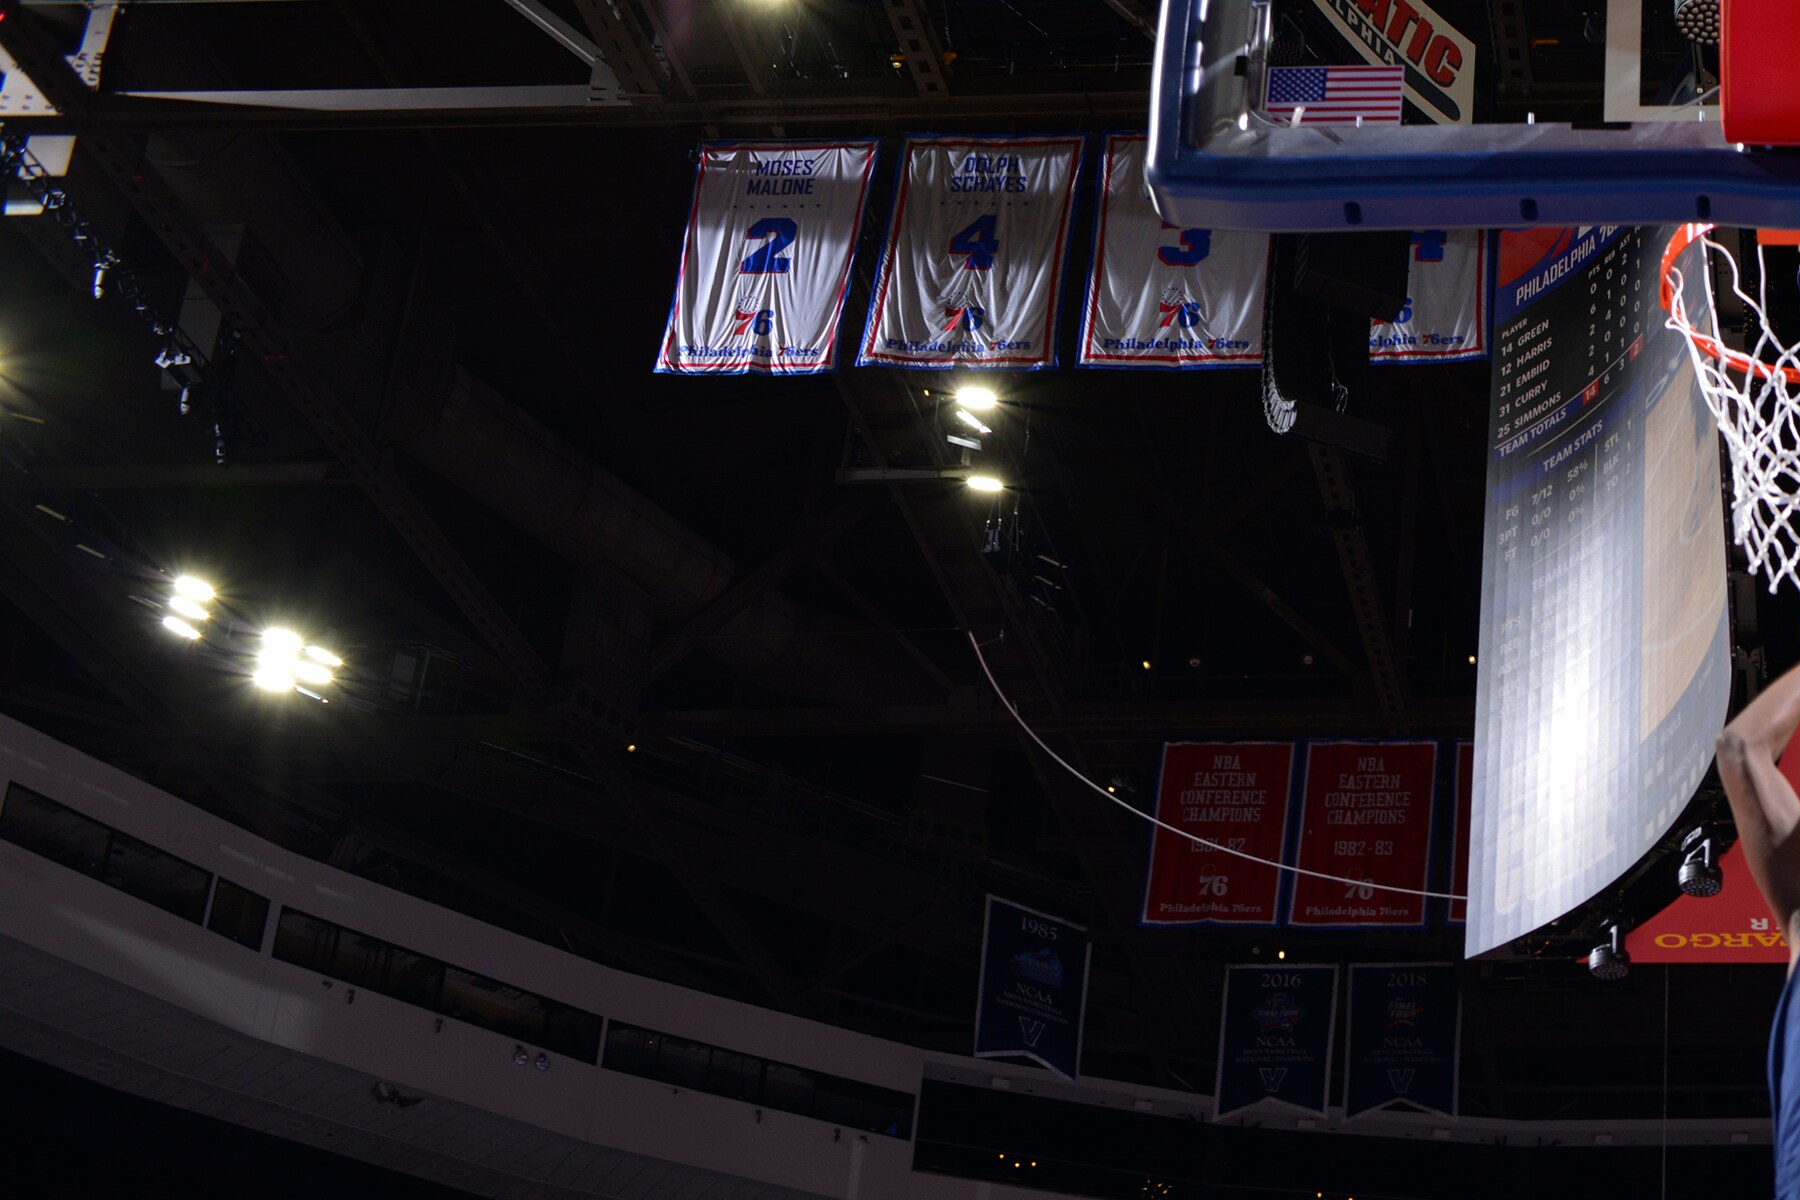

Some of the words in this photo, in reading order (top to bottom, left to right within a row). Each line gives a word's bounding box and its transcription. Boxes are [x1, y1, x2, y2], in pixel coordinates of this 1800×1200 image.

[756, 160, 814, 176] MOSES
[965, 156, 1020, 173] DOLPH
[747, 179, 815, 196] MALONE
[951, 176, 1026, 193] SCHAYES
[739, 218, 798, 274] 2
[948, 214, 1000, 270] 4
[1515, 237, 1596, 306] PHILADELPHIA
[1502, 318, 1528, 340] PLAYER
[1517, 319, 1549, 346] GREEN
[1104, 338, 1203, 351] Philadelphia
[1208, 338, 1249, 350] 76ers
[1516, 338, 1553, 367] HARRIS
[1516, 360, 1550, 388] EMBIID
[1515, 380, 1548, 408] CURRY
[1514, 391, 1562, 429] SIMMONS
[1499, 432, 1529, 457] TEAM
[1529, 409, 1567, 442] TOTALS
[1543, 446, 1573, 472] TEAM
[1573, 420, 1603, 454] STATS
[1212, 755, 1240, 770] NBA
[1357, 757, 1384, 772] NBA
[1194, 773, 1256, 787] EASTERN
[1338, 774, 1401, 789] EASTERN
[1180, 790, 1266, 805] CONFERENCE
[1324, 791, 1411, 807] CONFERENCE
[1182, 807, 1260, 822] CHAMPIONS
[1327, 810, 1405, 825] CHAMPIONS
[1333, 841, 1393, 856] 1982-83
[1021, 917, 1058, 941] 1985
[1261, 973, 1301, 988] 2016
[1387, 972, 1427, 987] 2018
